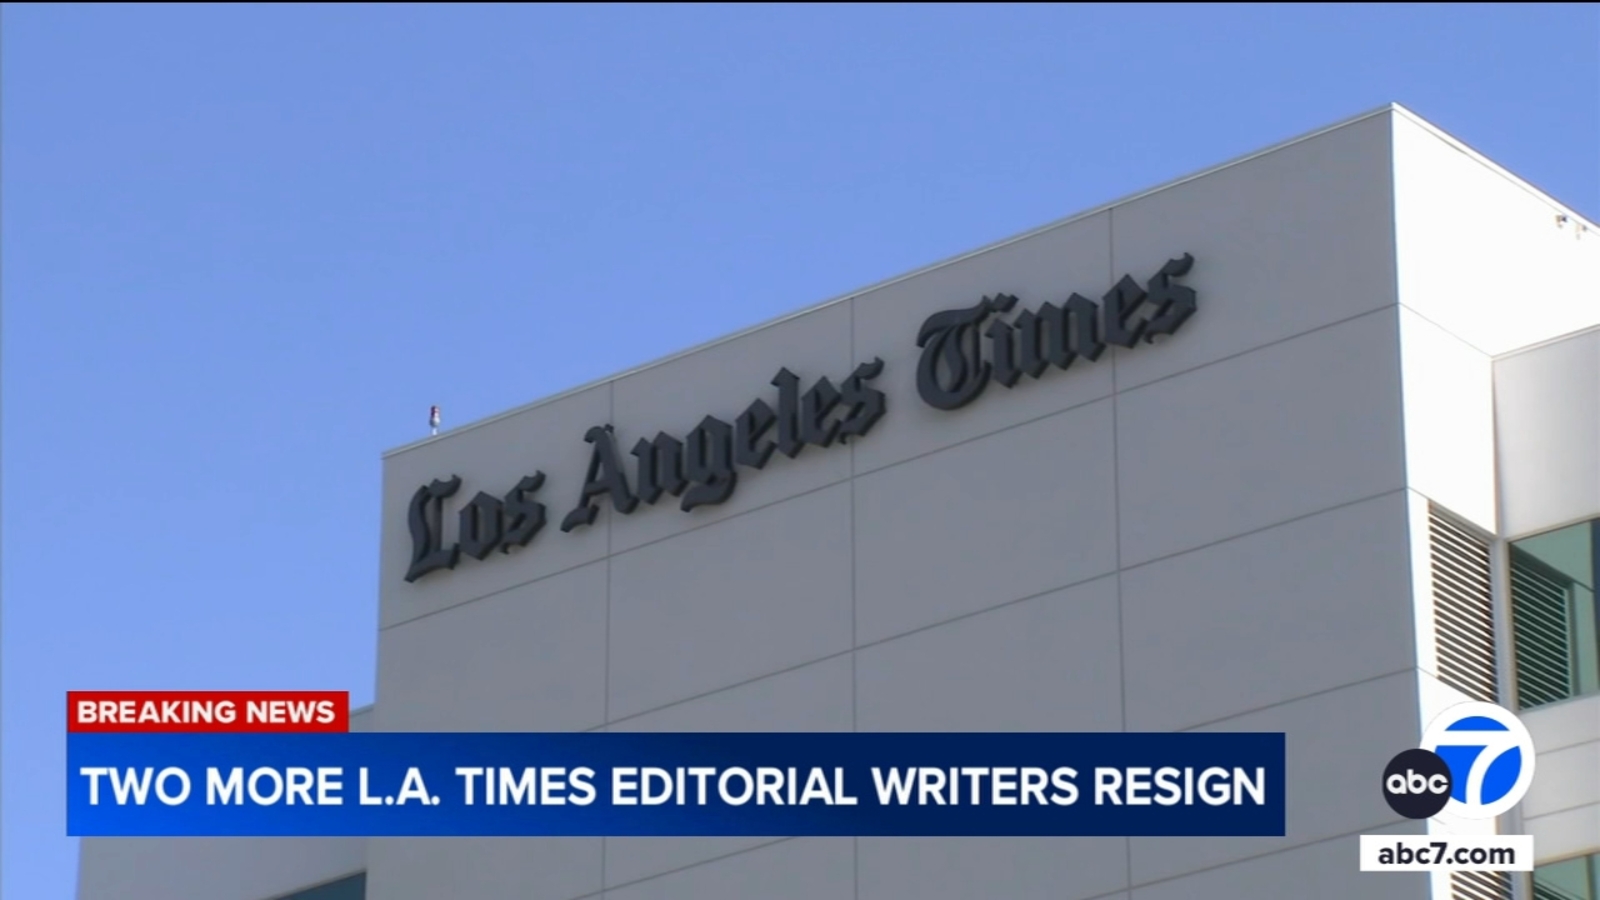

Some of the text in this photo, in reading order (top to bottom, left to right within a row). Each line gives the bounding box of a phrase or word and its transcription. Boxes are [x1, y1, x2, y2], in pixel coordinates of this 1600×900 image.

[404, 252, 1198, 584] Los Angeles Times
